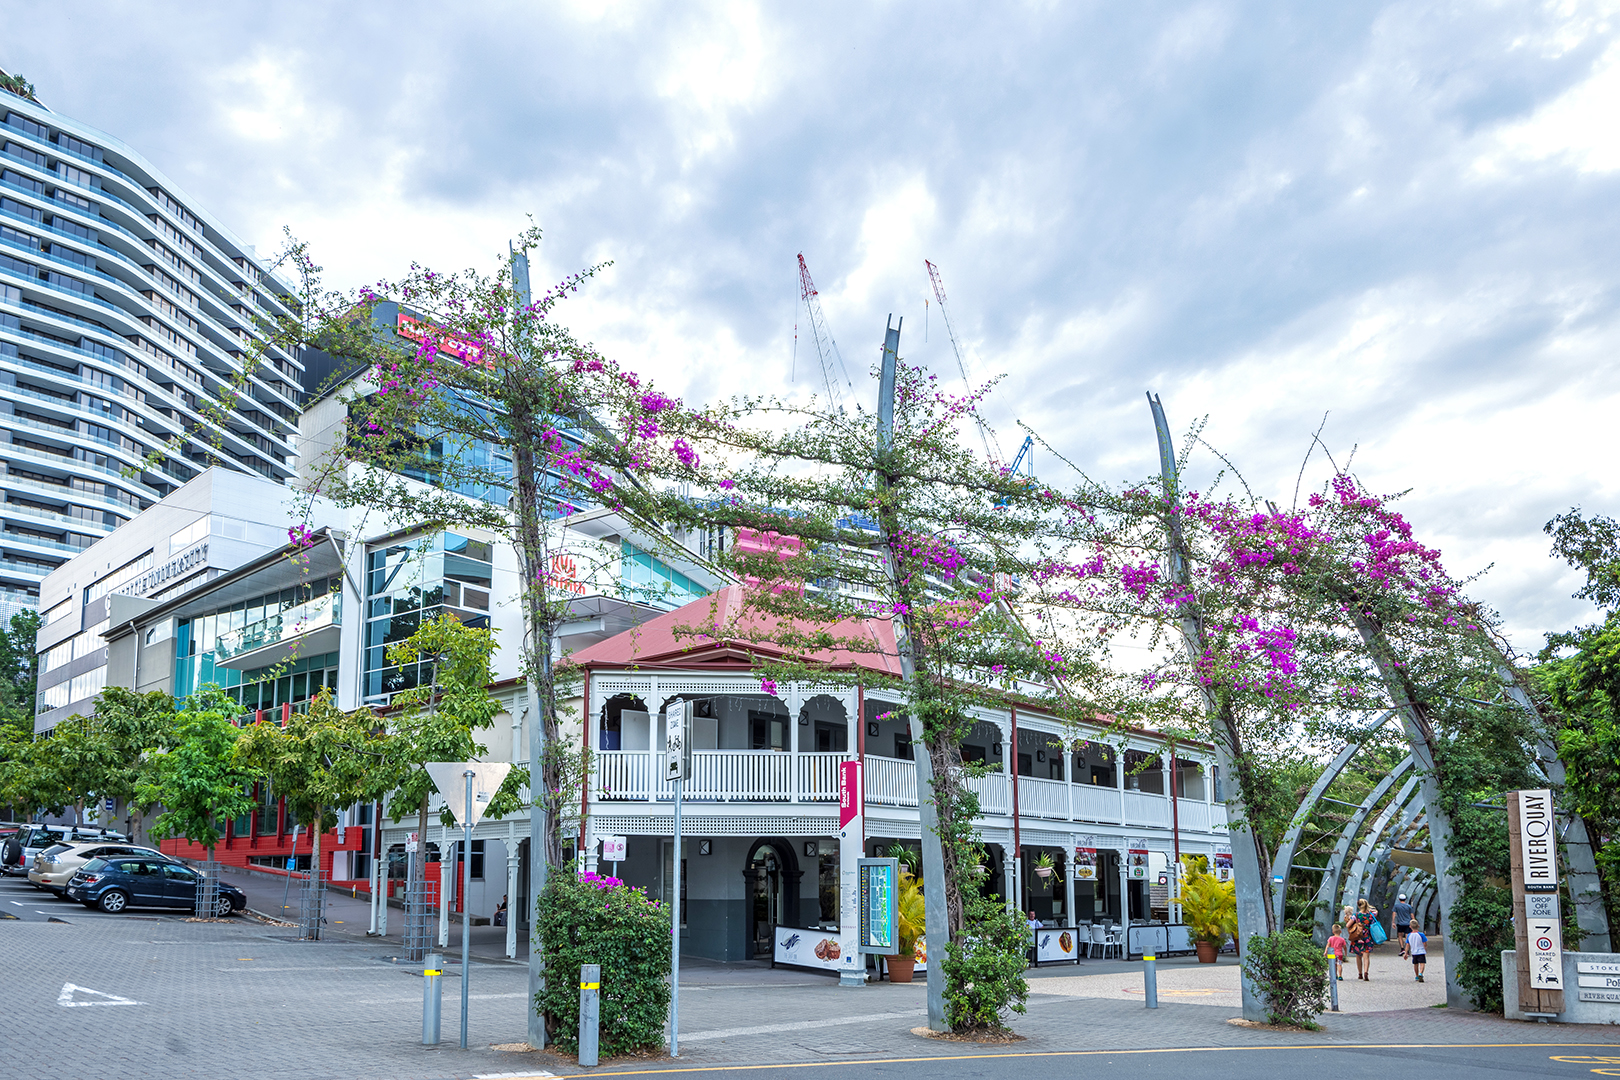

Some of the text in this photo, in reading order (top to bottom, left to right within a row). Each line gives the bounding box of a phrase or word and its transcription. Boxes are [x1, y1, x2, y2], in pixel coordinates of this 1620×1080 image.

[149, 543, 208, 590] UNIVERSITY
[1525, 795, 1550, 878] RIVERQUAY
[1540, 940, 1549, 948] 10
